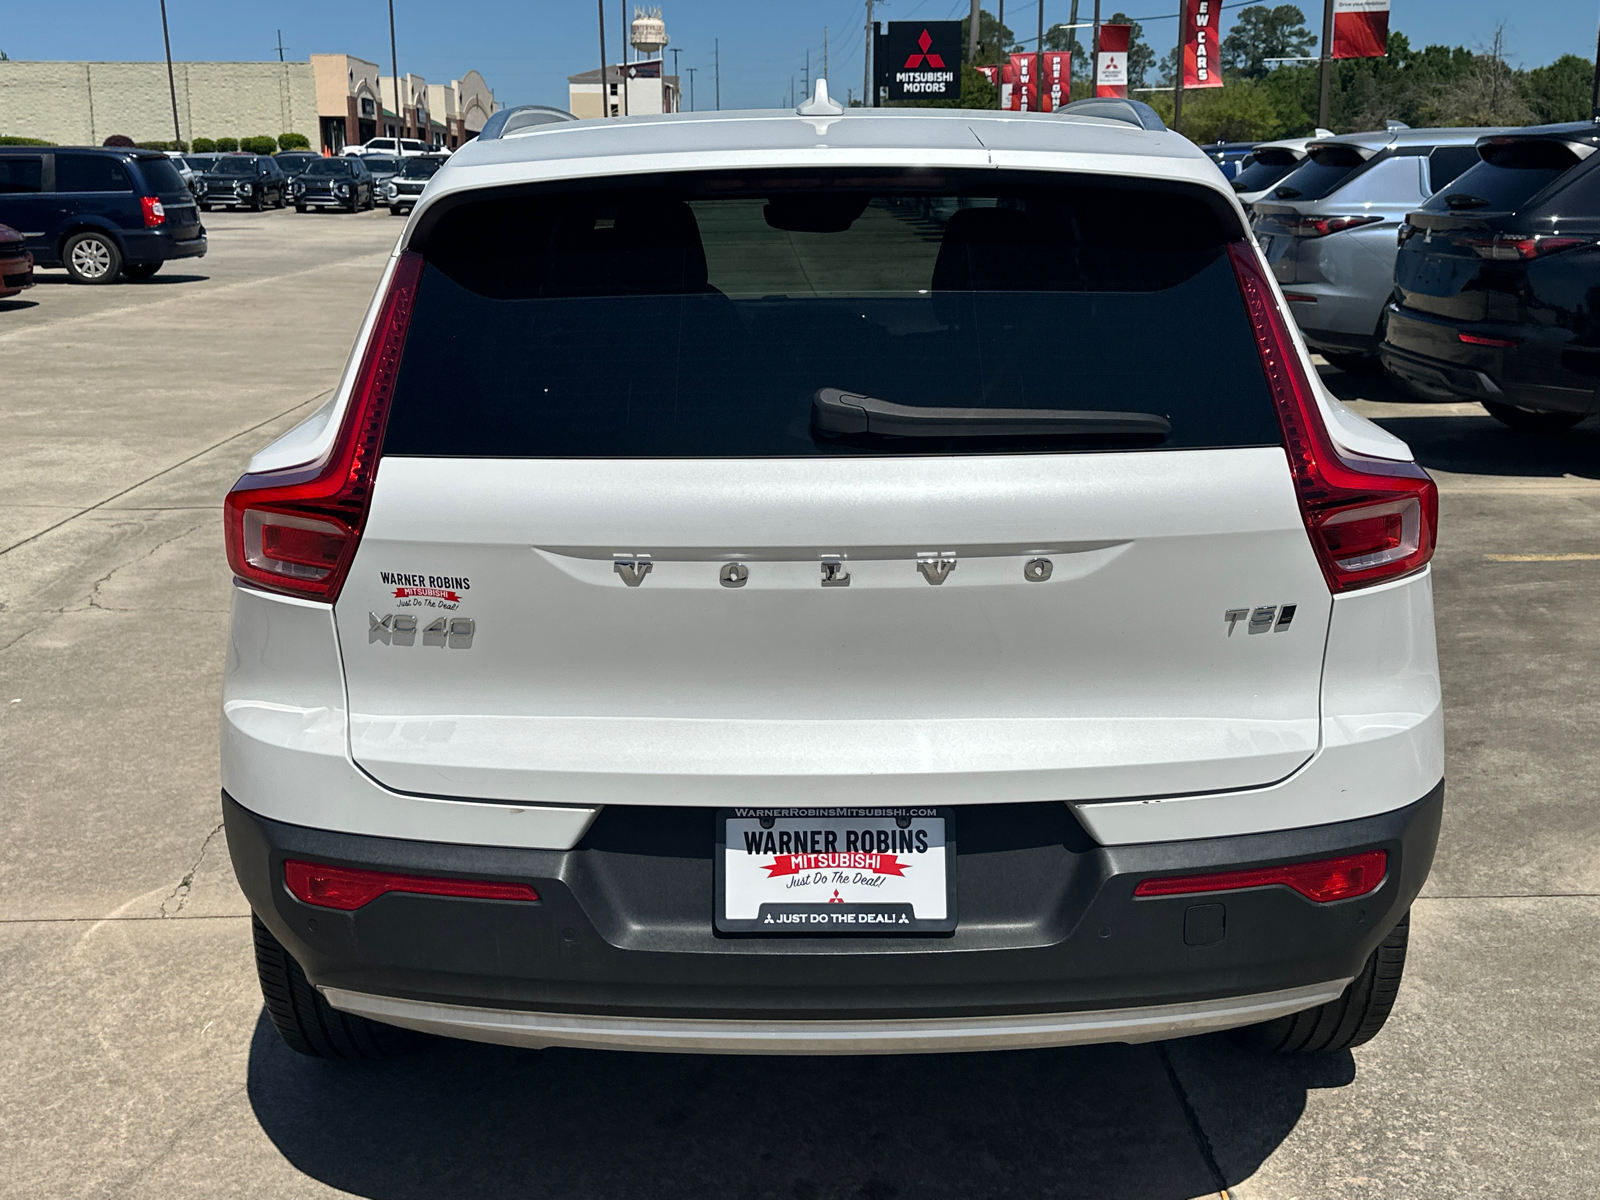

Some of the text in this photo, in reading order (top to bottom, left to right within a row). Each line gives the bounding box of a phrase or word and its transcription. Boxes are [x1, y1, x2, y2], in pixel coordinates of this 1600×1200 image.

[1196, 31, 1208, 81] CARS
[896, 71, 954, 83] MITSUBISHI
[1020, 58, 1030, 84] NEW
[903, 83, 946, 93] MOTORS
[614, 556, 1053, 587] VOLVO
[380, 571, 471, 590] WARNER ROBINS
[404, 588, 449, 598] MITSUBISHI
[396, 598, 460, 611] Just Do The Deal!
[744, 829, 929, 855] WARNER ROBINS
[791, 853, 881, 870] MITSUBISHI
[786, 871, 887, 889] Just Do The Deal!
[776, 913, 896, 924] JUST DO THE DEAL!
